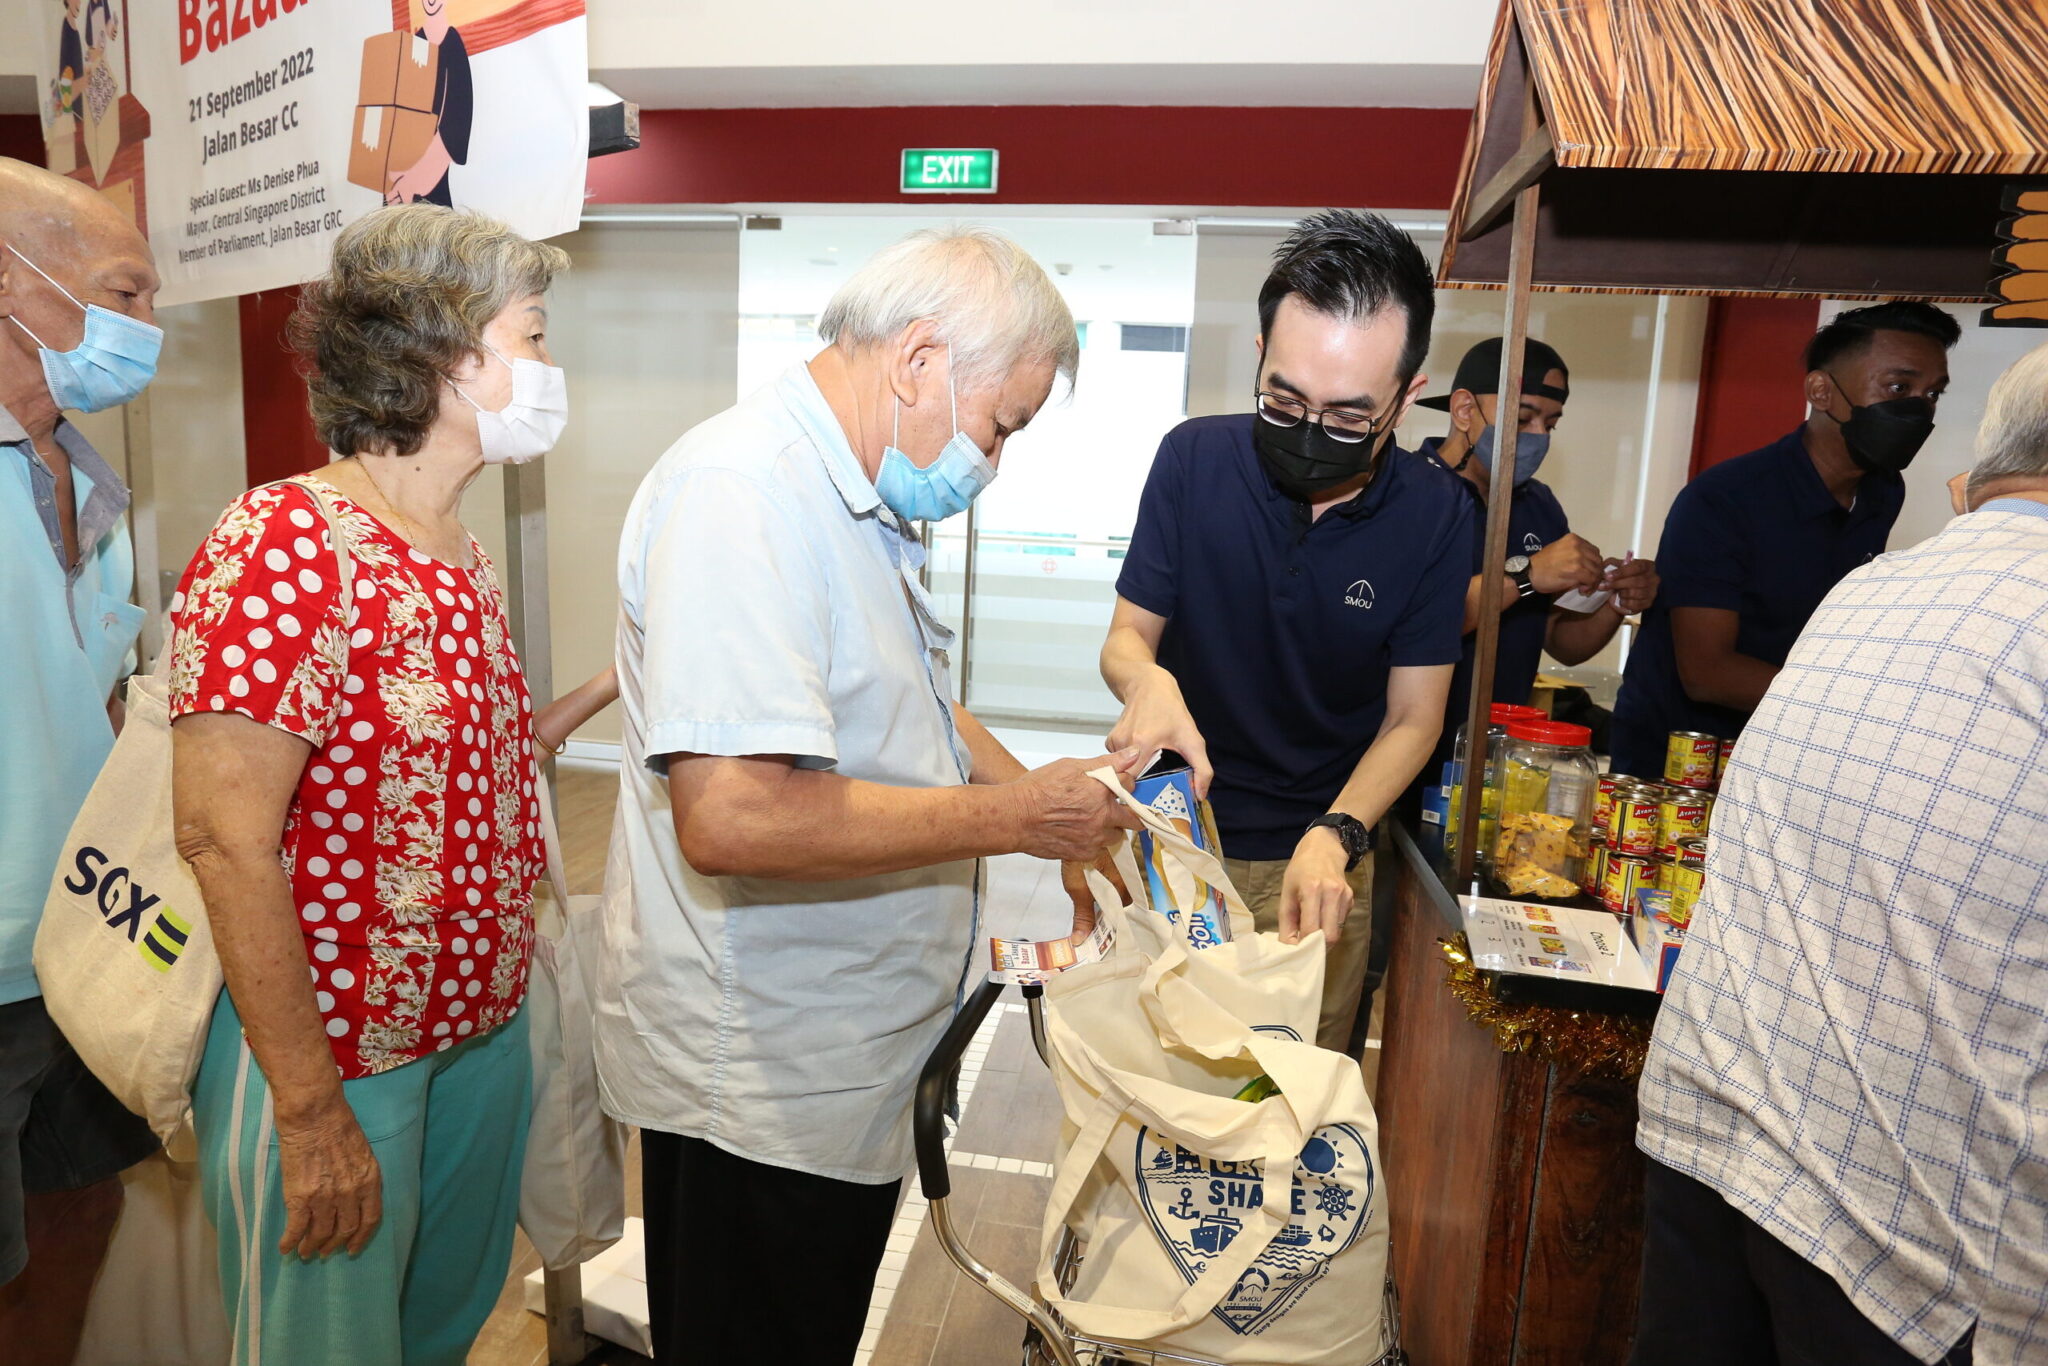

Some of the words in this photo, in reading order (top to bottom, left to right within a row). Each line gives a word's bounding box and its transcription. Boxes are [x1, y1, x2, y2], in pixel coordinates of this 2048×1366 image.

[189, 96, 203, 123] 21
[206, 68, 278, 118] September
[280, 47, 314, 86] 2022
[202, 130, 237, 165] Jalan
[240, 115, 278, 147] Besar
[281, 101, 299, 132] CC
[190, 186, 217, 215] Special
[219, 182, 247, 203] Guest:
[248, 177, 261, 195] Ms
[263, 167, 295, 192] Denise
[296, 160, 319, 182] Phua
[921, 154, 976, 184] EXIT
[186, 218, 211, 239] Mayor,
[212, 208, 242, 231] Central
[244, 198, 289, 225] Singapore
[290, 186, 326, 211] District
[208, 240, 217, 257] of
[217, 230, 269, 256] Parliament,
[269, 223, 292, 248] Jalan
[294, 217, 321, 238] Besar
[323, 208, 343, 231] GRC
[1344, 595, 1373, 609] SMOU
[1634, 807, 1653, 816] AYAM
[1678, 809, 1696, 817] AYAM
[64, 846, 161, 943] SGX
[1208, 1179, 1306, 1216] SHAE
[1239, 1295, 1263, 1303] SMOU
[1253, 1321, 1271, 1336] Stamp
[1269, 1307, 1290, 1326] designs
[1288, 1298, 1298, 1309] are
[1295, 1286, 1309, 1301] hand
[1323, 1266, 1331, 1276] by
